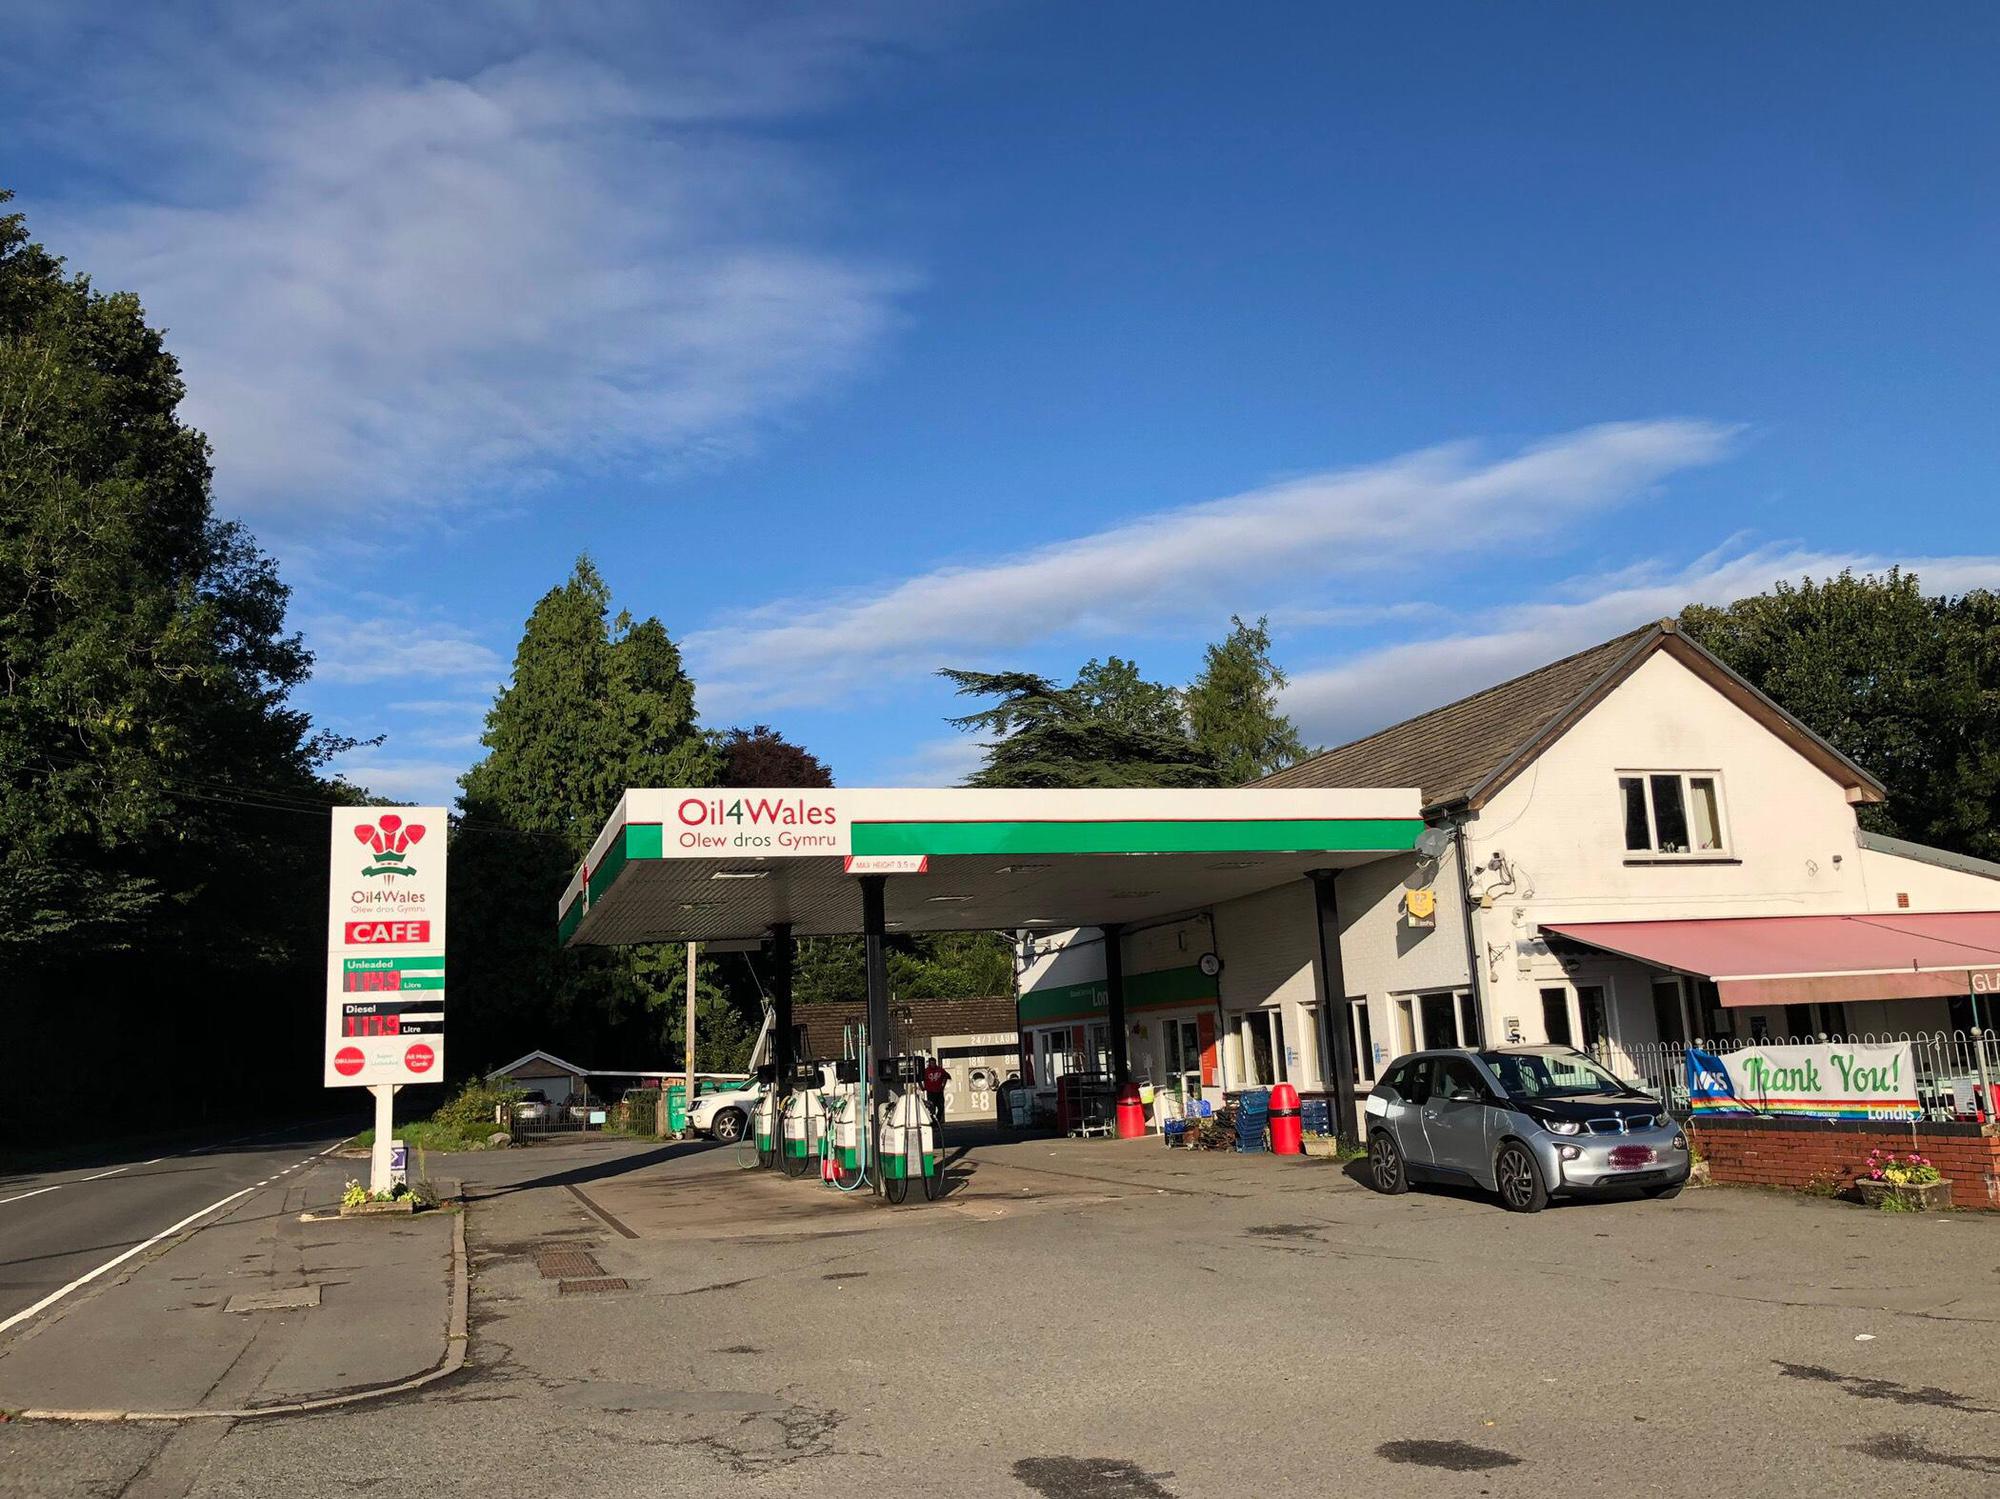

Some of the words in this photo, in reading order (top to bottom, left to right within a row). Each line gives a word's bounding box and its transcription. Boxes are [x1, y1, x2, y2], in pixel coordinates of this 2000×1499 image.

[678, 798, 836, 826] Oil4Wales
[679, 832, 727, 848] Olew
[733, 831, 771, 848] dros
[778, 831, 836, 851] Gymru
[352, 890, 425, 903] Oil4Wales
[351, 905, 372, 913] Olew
[376, 904, 394, 913] dros
[397, 904, 425, 914] Gymru
[352, 923, 421, 942] CAFE
[347, 960, 393, 969] Unleaded
[346, 1005, 376, 1014] Diesel
[403, 1025, 421, 1033] Litre
[1694, 1071, 1728, 1091] NHS
[1743, 1056, 1822, 1093] Thank
[1830, 1054, 1900, 1093] You!
[1867, 1105, 1915, 1121] Londis
